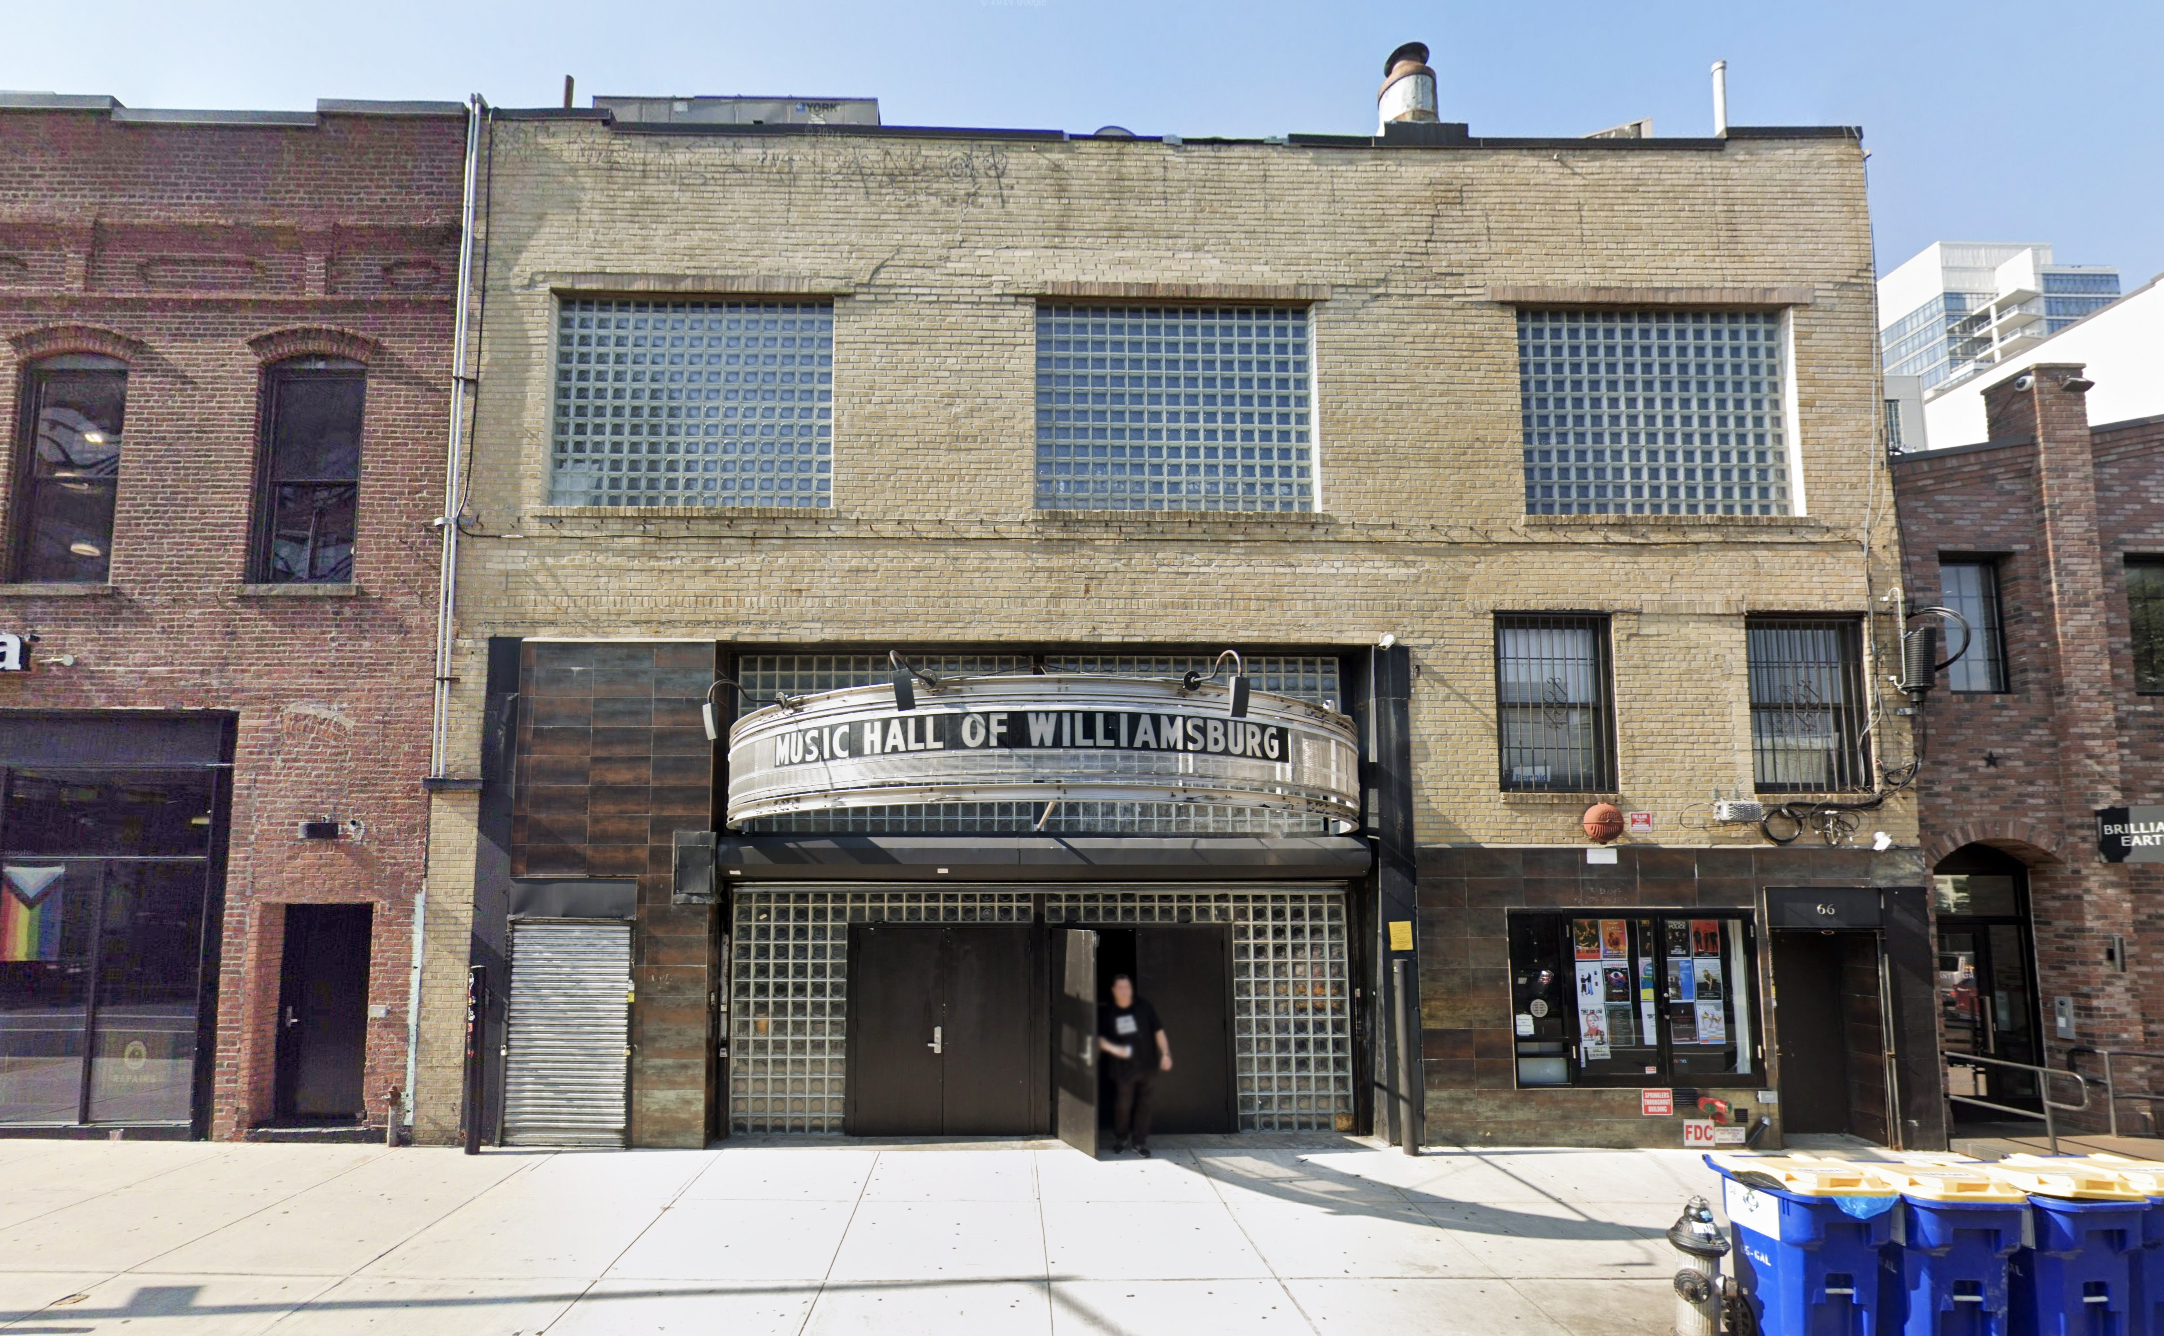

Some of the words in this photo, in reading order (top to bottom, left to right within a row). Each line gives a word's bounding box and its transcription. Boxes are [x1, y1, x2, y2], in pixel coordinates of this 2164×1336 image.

[806, 102, 837, 113] YORK
[0, 633, 22, 671] a
[773, 724, 850, 766] MUSIC
[862, 714, 944, 756] HALL
[961, 711, 1009, 749] OF
[1027, 710, 1280, 760] WILLIAMSBURG
[1515, 772, 1548, 783] Bernie
[2103, 821, 2164, 835] BRILLIA
[2121, 834, 2164, 847] EART
[1816, 903, 1836, 915] 66
[1644, 1098, 1671, 1106] THROUGHOUT
[1685, 1124, 1714, 1141] FDC
